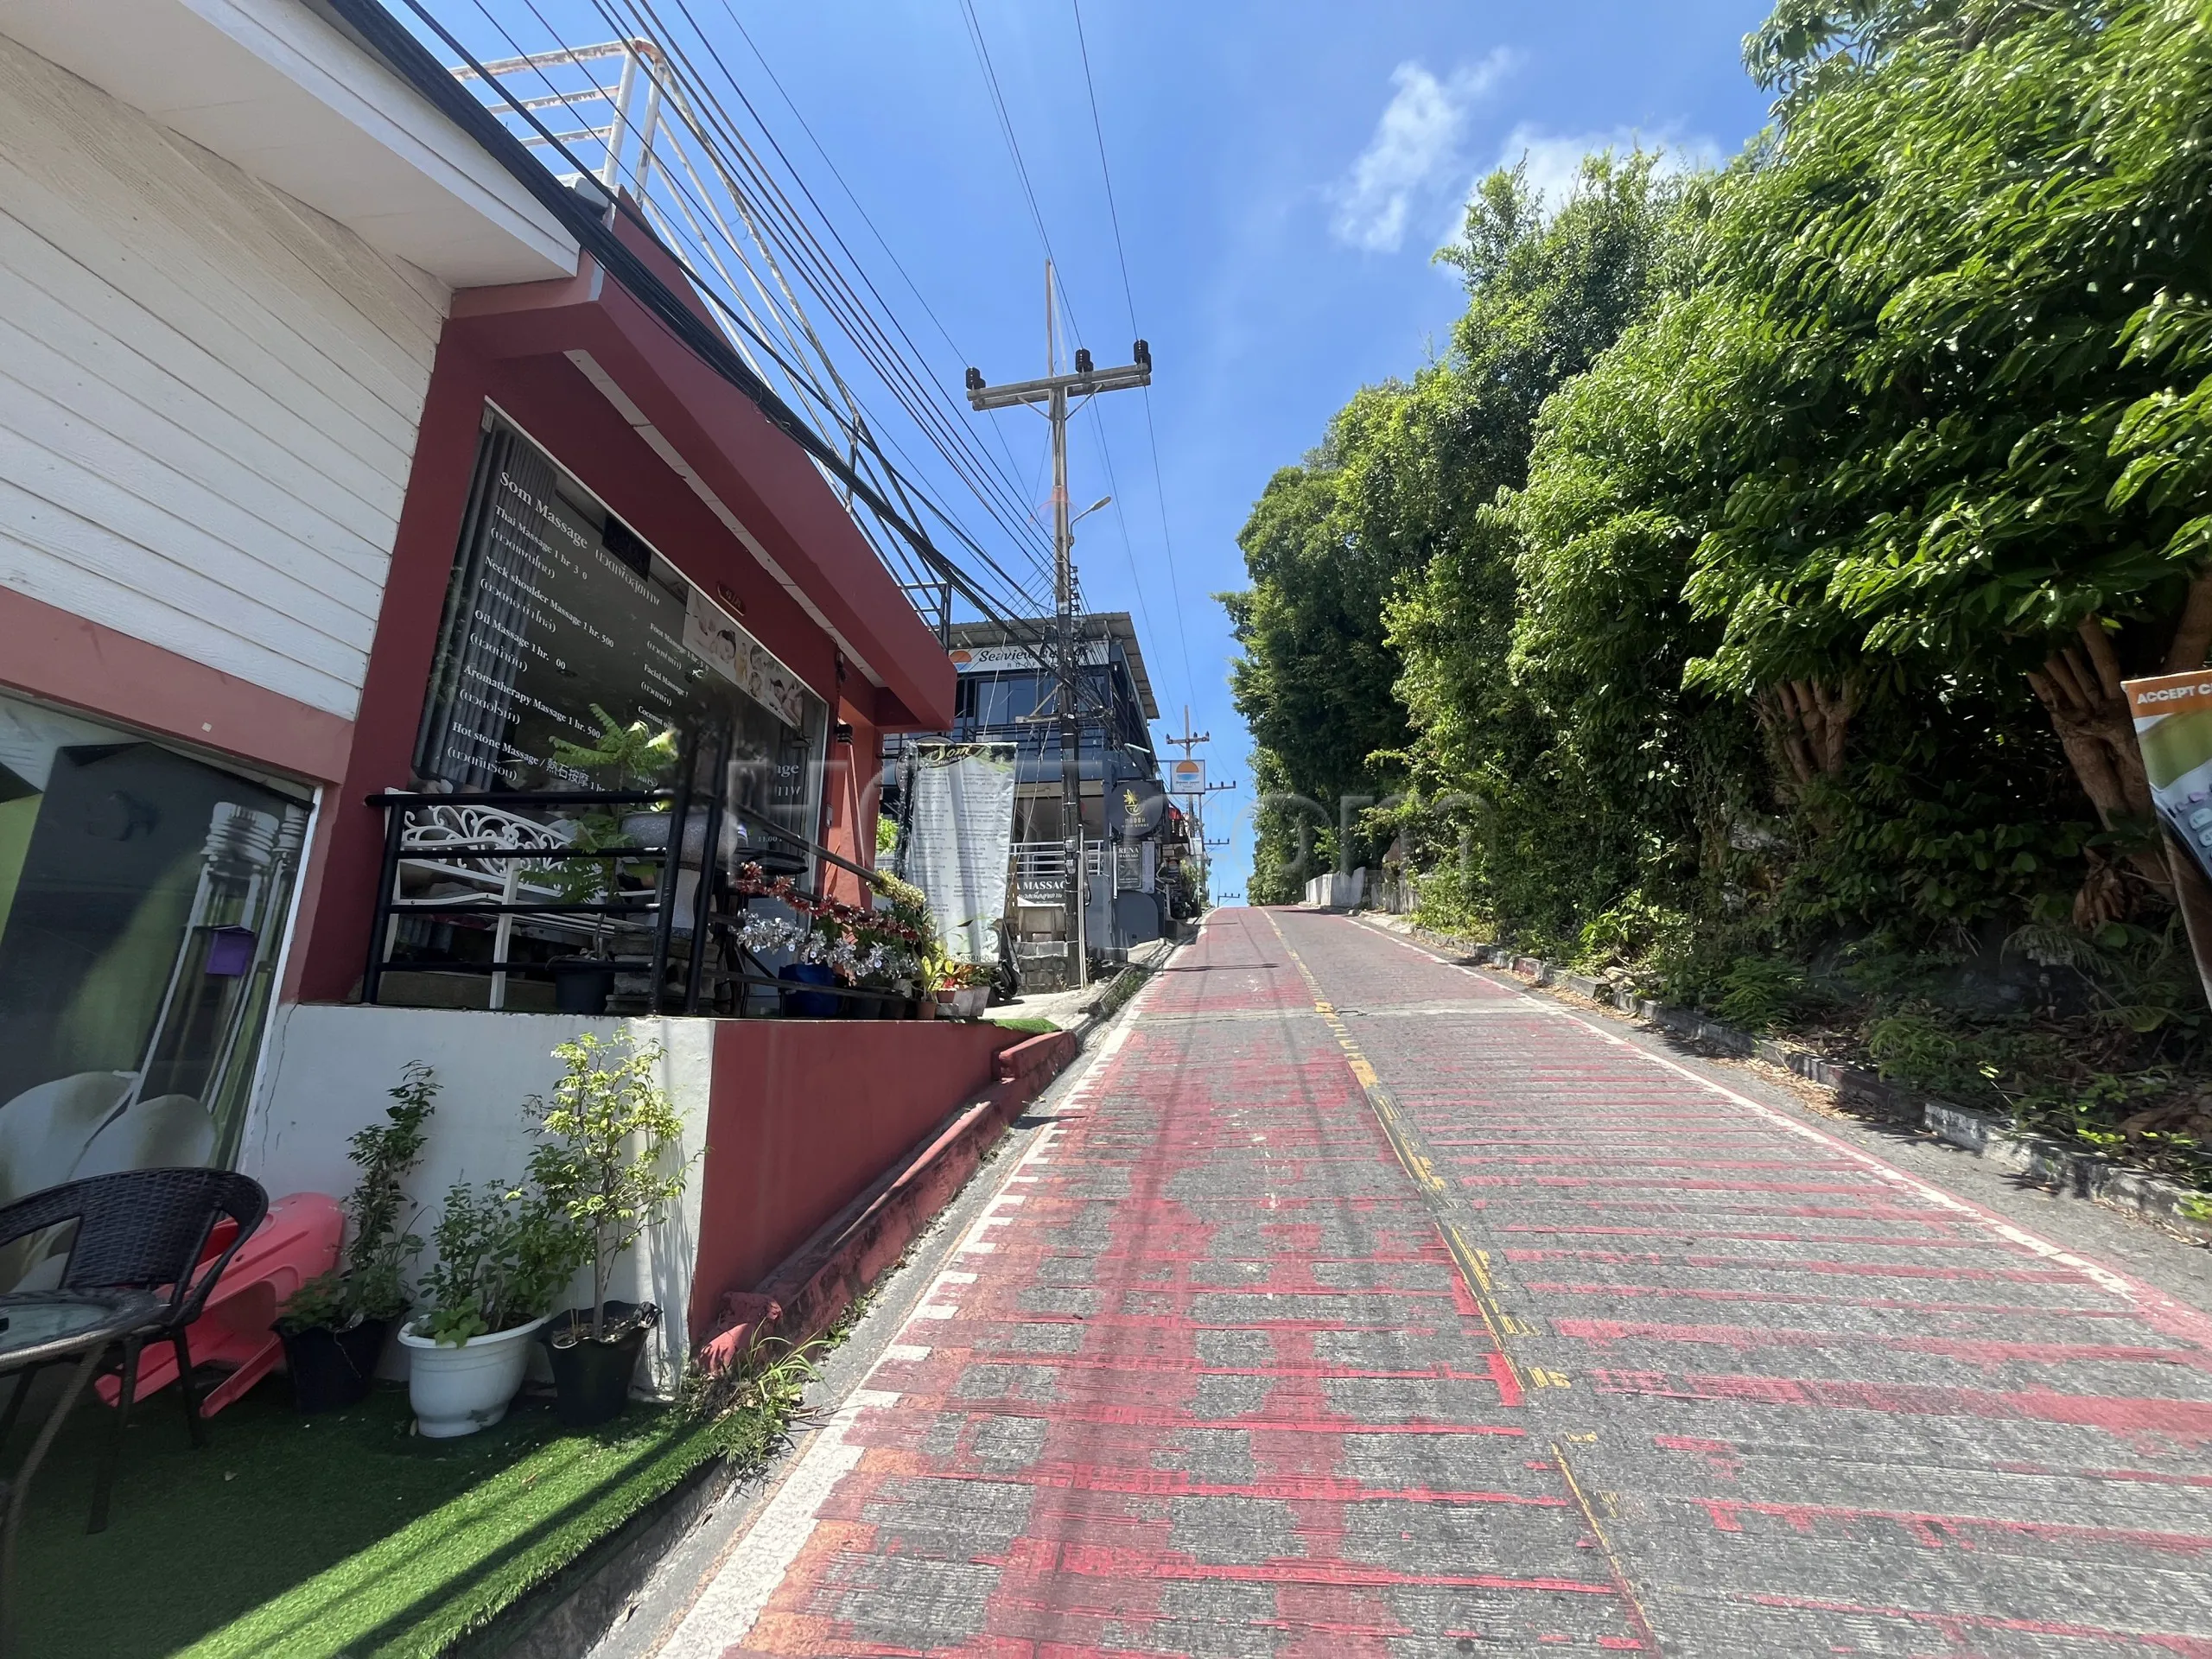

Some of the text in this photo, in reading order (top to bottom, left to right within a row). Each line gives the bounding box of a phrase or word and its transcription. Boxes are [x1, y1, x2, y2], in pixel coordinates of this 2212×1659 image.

[495, 505, 516, 526] Thai
[518, 523, 552, 554] Massage
[554, 550, 559, 559] 1
[500, 472, 588, 549] Som Massage
[485, 556, 614, 648] Neck shoulder Massage 1 hr. 500
[475, 610, 490, 625] Oil
[492, 620, 530, 649] Massage
[531, 644, 536, 652] 1
[537, 645, 550, 661] hr.
[650, 622, 664, 639] Foot
[463, 664, 601, 740] Aromatherapy Massage 1 hr. 500
[644, 663, 663, 682] Facial
[663, 674, 684, 697] Massage
[2137, 685, 2196, 704] ACCEPT
[638, 705, 667, 726] Coconut
[452, 721, 472, 736] Hot
[474, 732, 500, 749] stone
[502, 742, 539, 766] Massage
